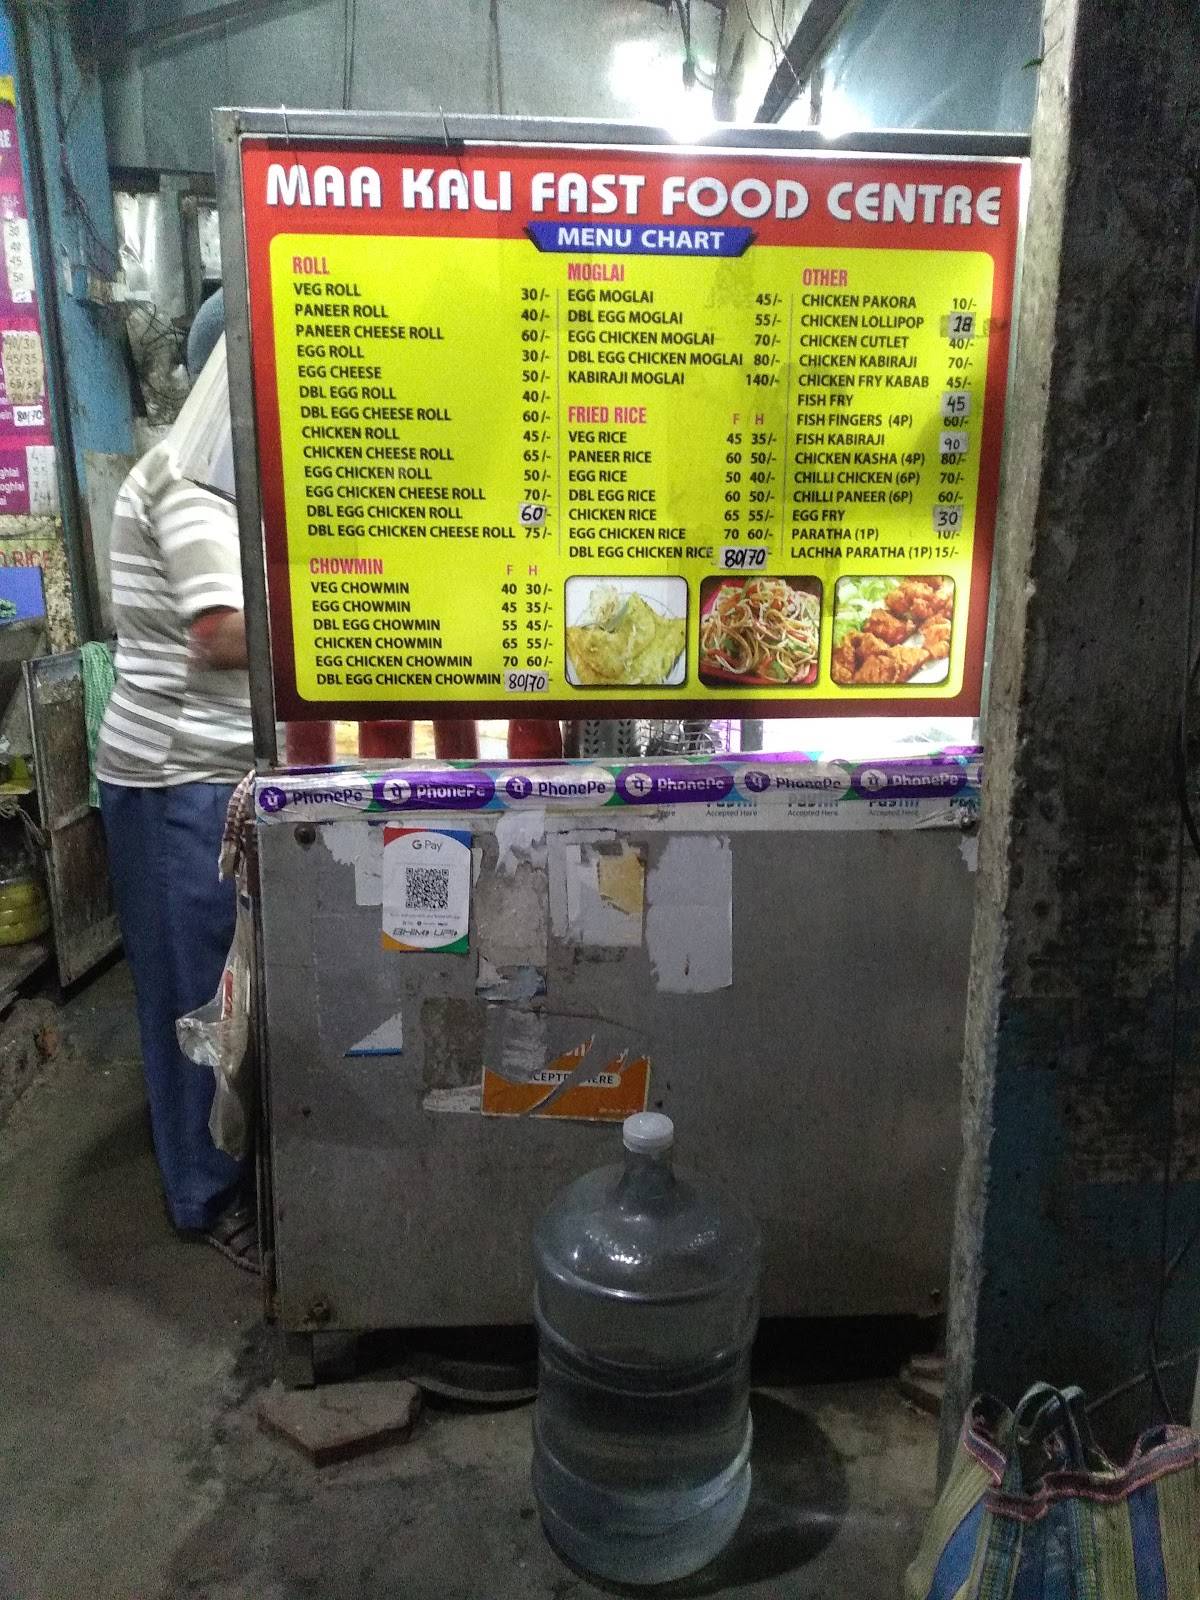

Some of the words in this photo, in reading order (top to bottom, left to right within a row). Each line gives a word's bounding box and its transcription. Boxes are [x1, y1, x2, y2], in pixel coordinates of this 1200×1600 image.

[266, 164, 381, 208] MAA
[401, 167, 512, 211] KALI
[531, 172, 645, 214] FAST
[662, 176, 808, 219] FOOD
[827, 182, 1001, 225] CENTRE
[557, 227, 632, 247] MENU
[641, 229, 724, 250] CHART
[292, 256, 329, 275] ROLL
[567, 263, 625, 282] MOGLAI
[802, 268, 848, 287] OTHER
[293, 282, 322, 296] VEG
[325, 283, 361, 297] ROLL
[568, 288, 596, 302] EGG
[599, 289, 654, 303] MOGLAI
[802, 294, 860, 308] CHICKEN
[862, 295, 917, 309] PAKORA
[295, 303, 350, 317] PANEER
[353, 304, 388, 318] ROLL
[801, 314, 858, 328] CHICKEN
[861, 315, 924, 329] LOLLIPOP
[296, 324, 351, 338] PANEER
[353, 325, 406, 339] CHEESE
[409, 326, 444, 340] ROLL
[568, 329, 596, 343] EGG
[599, 331, 658, 344] CHICKEN
[661, 332, 715, 346] MOGLAI
[800, 334, 857, 348] CHICKEN
[860, 335, 909, 348] CUTLET
[568, 350, 594, 363] DBL
[598, 351, 625, 364] EGG
[628, 351, 687, 365] CHICKEN
[690, 352, 743, 366] MOGLAI
[799, 354, 856, 368] CHICKEN
[859, 355, 917, 368] KABIRAJI
[298, 365, 327, 378] EGG
[330, 365, 382, 379] CHEESE
[568, 370, 628, 384] KABIRAJI
[631, 371, 685, 385] MOGLAI
[798, 373, 855, 388] CHICKEN
[858, 375, 882, 387] FRY
[885, 375, 929, 388] KABAB
[946, 396, 966, 413] 45
[568, 406, 609, 424] FRIED
[614, 406, 647, 424] RICE
[797, 413, 826, 426] FISH
[828, 414, 882, 427] FINGERS
[888, 414, 913, 428] (4P)
[301, 425, 362, 440] CHICKEN
[364, 427, 400, 440] ROLL
[568, 430, 595, 443] VEG
[598, 431, 627, 444] RICE
[726, 432, 742, 445] 45
[796, 433, 824, 445] FISH
[827, 433, 885, 446] KABIRAJI
[303, 445, 363, 459] CHICKEN
[365, 446, 416, 460] CHEESE
[420, 447, 454, 461] ROLL
[568, 450, 620, 463] PANEER
[623, 450, 652, 464] RICE
[725, 452, 742, 464] 60
[794, 452, 851, 465] CHICKEN
[854, 452, 897, 465] KASHA
[901, 452, 925, 466] (4P)
[794, 471, 835, 484] CHILLI
[837, 471, 893, 484] CHICKEN
[895, 471, 920, 486] (6P)
[305, 485, 334, 498] EGG
[336, 485, 396, 499] CHICKEN
[398, 486, 449, 500] CHEESE
[452, 487, 486, 500] ROLL
[792, 490, 834, 503] CHILLI
[836, 490, 886, 503] PANEER
[888, 490, 913, 505] (6P)
[521, 504, 543, 521] 60
[792, 509, 819, 522] EGG
[821, 509, 845, 522] FRY
[937, 511, 958, 526] 30
[308, 524, 334, 537] DBL
[337, 524, 365, 537] EGG
[368, 525, 426, 538] CHICKEN
[430, 526, 479, 538] CHEESE
[482, 526, 515, 539] ROLL
[569, 527, 596, 539] EGG
[598, 528, 655, 540] CHICKEN
[658, 528, 686, 540] RICE
[724, 528, 740, 540] 70
[792, 528, 851, 540] PARATHA
[855, 528, 879, 541] (1P)
[569, 546, 594, 558] DBL
[597, 546, 624, 558] EGG
[626, 546, 683, 558] CHICKEN
[685, 546, 714, 559] RICE
[791, 546, 842, 559] LACHHA
[846, 546, 905, 558] PARATHA
[908, 546, 932, 559] (1P)
[309, 557, 383, 575] CHOWMIN
[310, 581, 338, 594] VEG
[341, 581, 409, 594] CHOWMIN
[314, 637, 372, 649] CHICKEN
[375, 637, 442, 649] CHOWMIN
[315, 655, 343, 667] EGG
[346, 655, 403, 667] CHICKEN
[406, 655, 472, 667] CHOWMIN
[316, 673, 342, 685] DBL
[345, 673, 373, 685] EGG
[375, 673, 432, 685] CHICKEN
[435, 673, 501, 685] CHOWMIN
[538, 781, 606, 796] PhonePe
[424, 840, 443, 852] Pay
